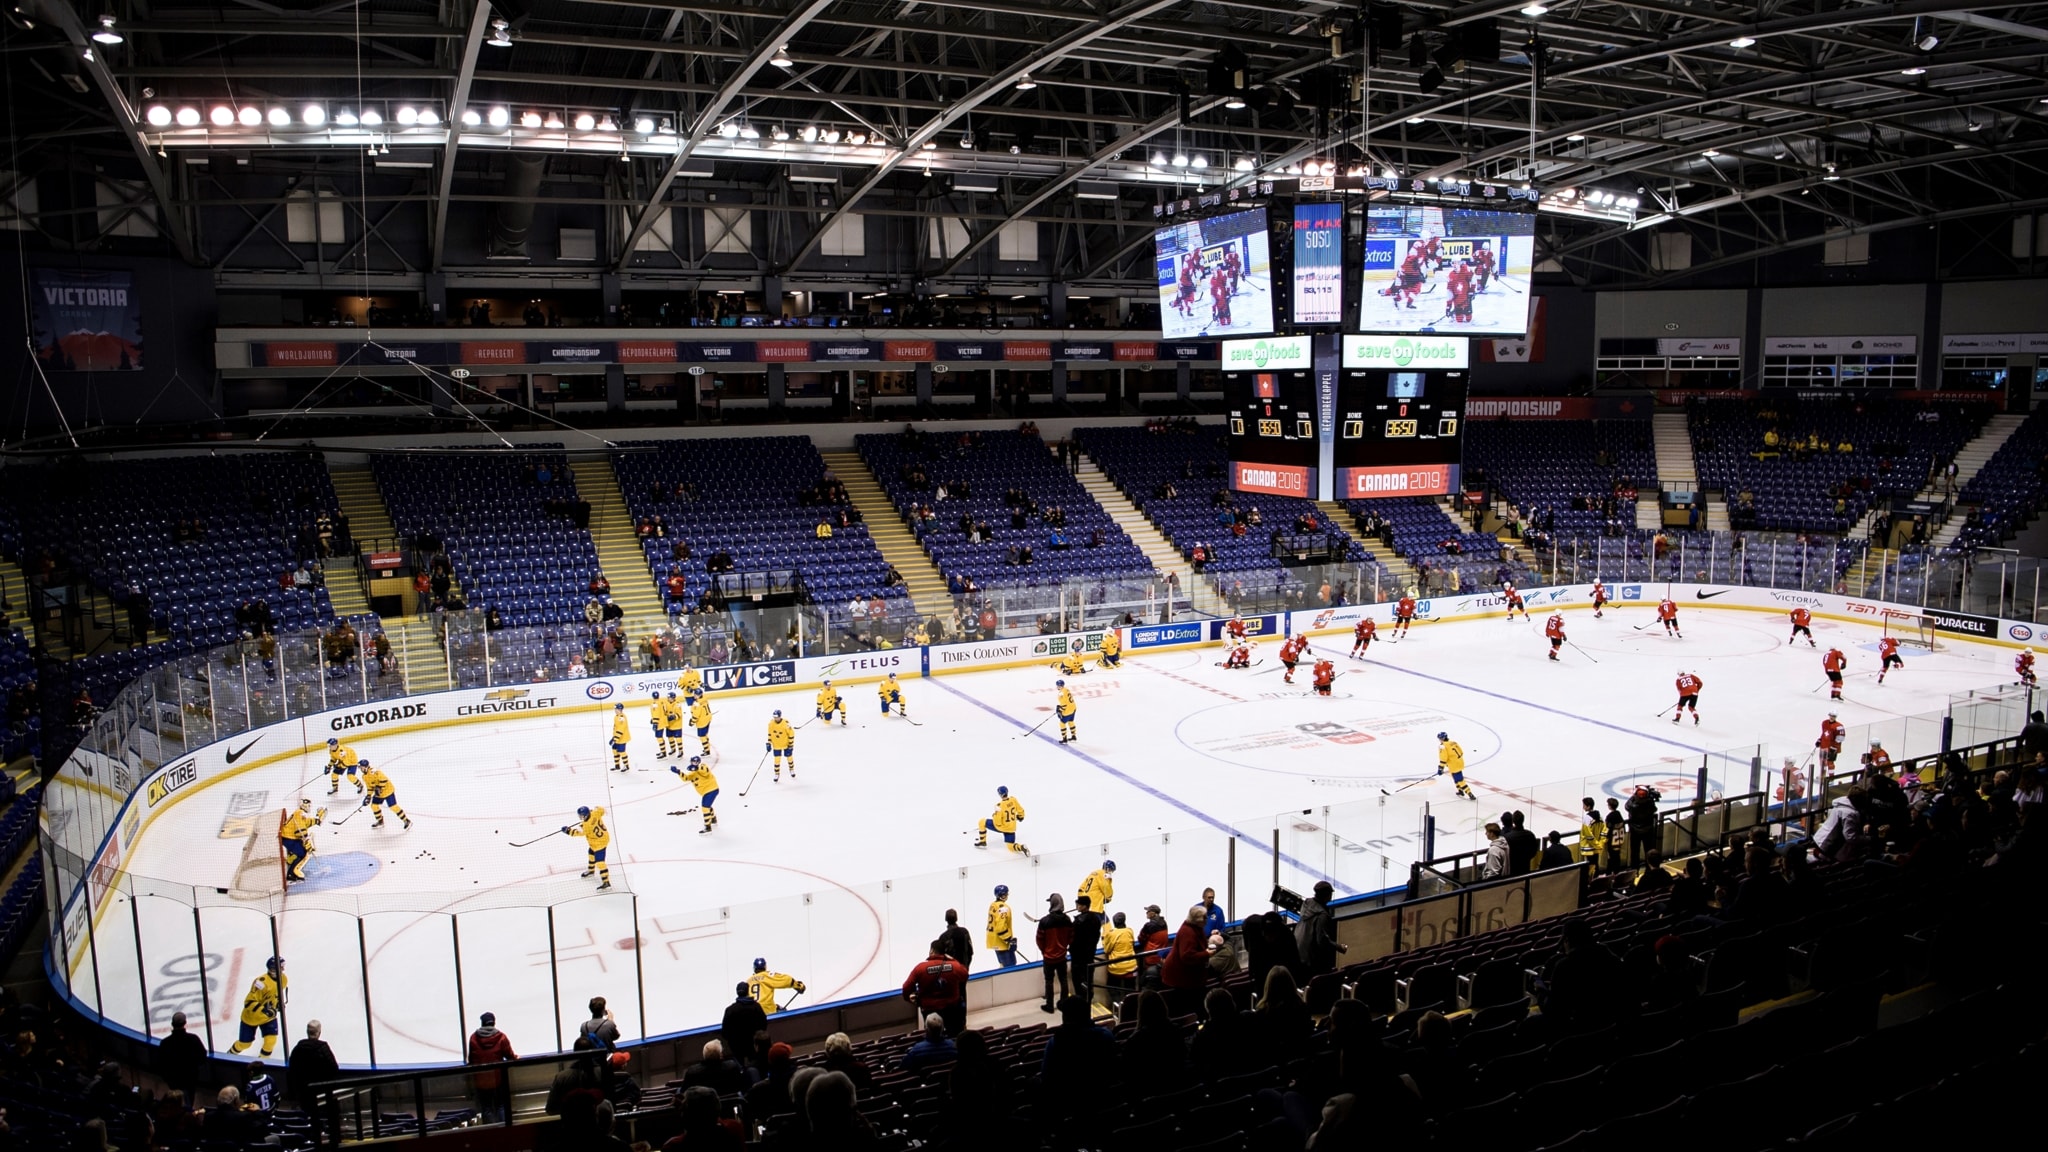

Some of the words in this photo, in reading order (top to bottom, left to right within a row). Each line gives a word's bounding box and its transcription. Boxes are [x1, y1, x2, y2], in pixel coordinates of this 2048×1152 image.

[1301, 178, 1333, 188] GSL
[44, 288, 127, 306] VICTORIA
[384, 350, 416, 358] VICTORIA
[552, 349, 600, 358] CHAMPIONSHIP
[827, 347, 869, 355] CHAMPIONSHIP
[454, 369, 467, 377] 115
[690, 367, 704, 375] 116
[1466, 401, 1562, 416] HAMPIONSHIP
[1242, 468, 1277, 487] CANADA
[1278, 472, 1301, 490] 2019
[1357, 473, 1408, 492] CANADA
[1409, 472, 1440, 490] 2019
[1846, 602, 1877, 614] TSN
[1935, 616, 1986, 632] DURACELL
[942, 651, 970, 663] TIMES
[973, 646, 1018, 660] COLONIST
[850, 656, 900, 670] TELUS
[638, 680, 679, 693] Synergy
[1681, 677, 1693, 688] 23
[457, 697, 557, 715] CHEVROLET
[331, 703, 427, 731] GATORADE
[148, 772, 170, 808] OK
[169, 763, 194, 787] TIRE
[1005, 807, 1015, 822] 15
[1612, 830, 1625, 846] 29
[261, 1093, 270, 1111] 6
